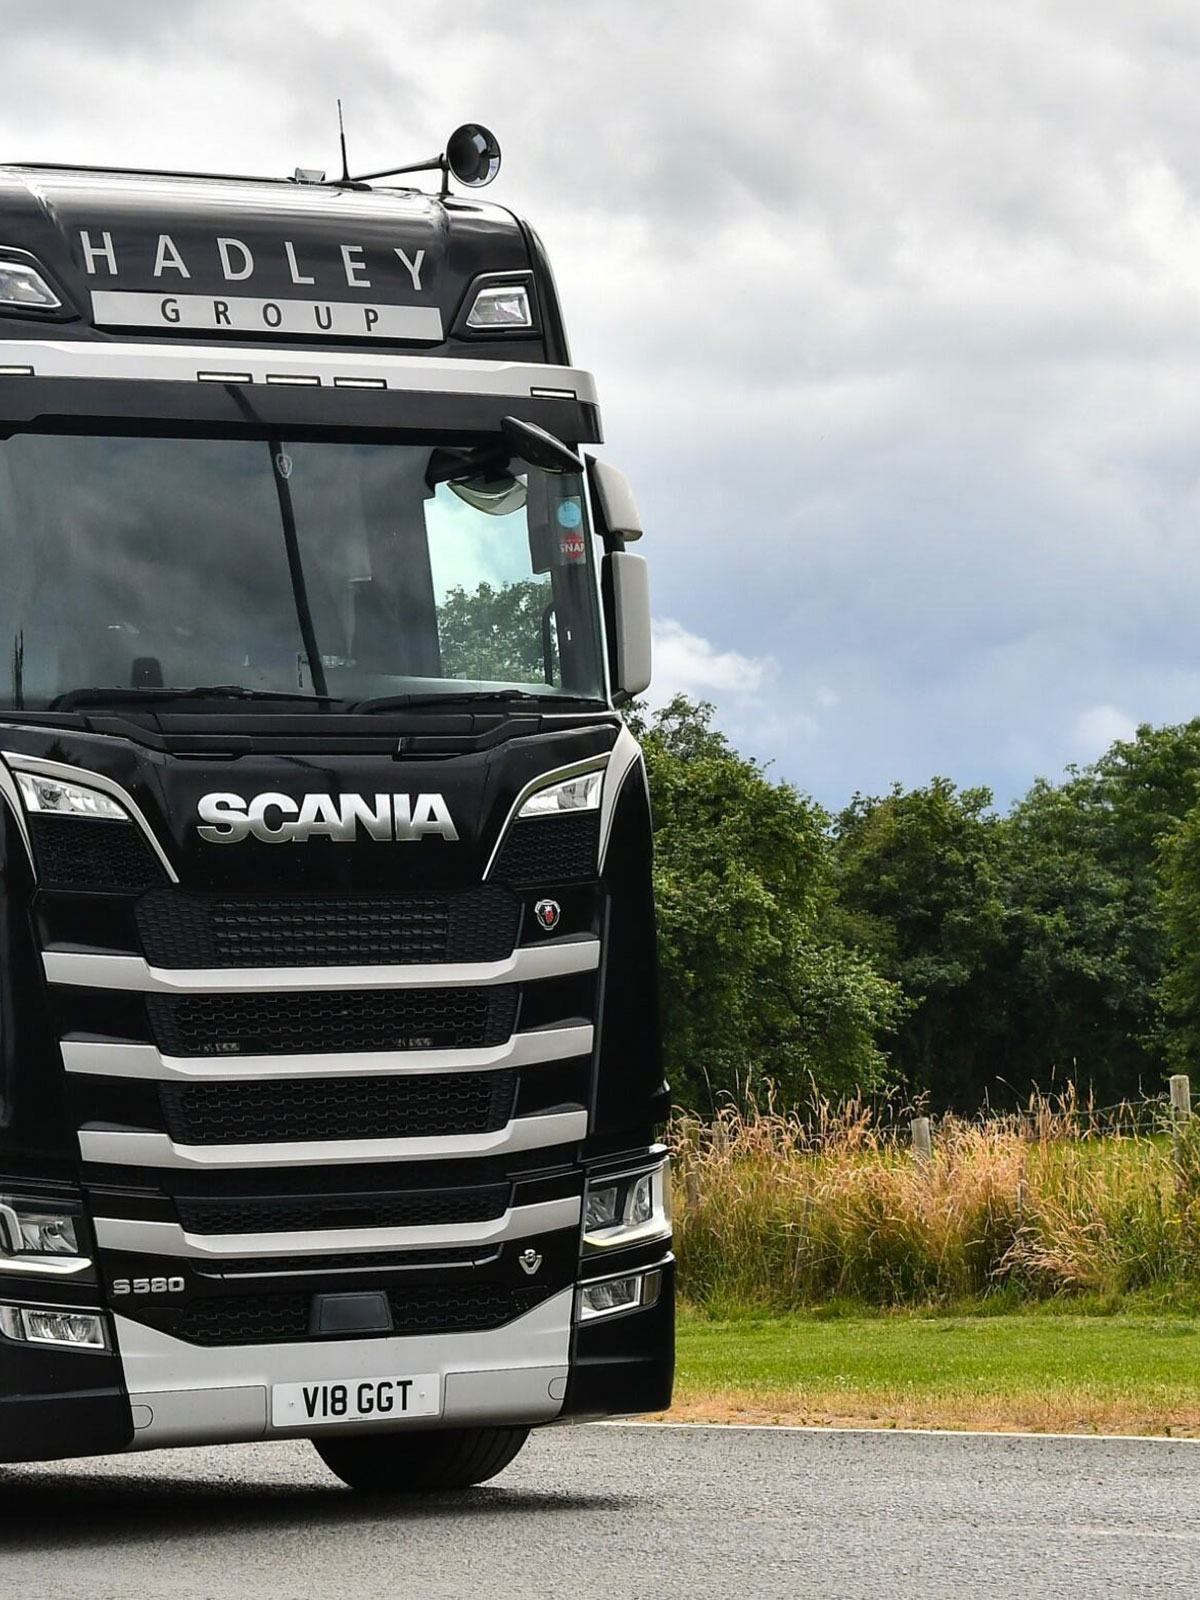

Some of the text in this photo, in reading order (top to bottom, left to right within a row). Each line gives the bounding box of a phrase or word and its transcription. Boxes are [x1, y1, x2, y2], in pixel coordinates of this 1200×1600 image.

[80, 230, 425, 291] HADLEY
[160, 298, 379, 332] GROUP
[197, 792, 459, 843] SCANIA
[302, 1380, 413, 1418] V18 GGT
